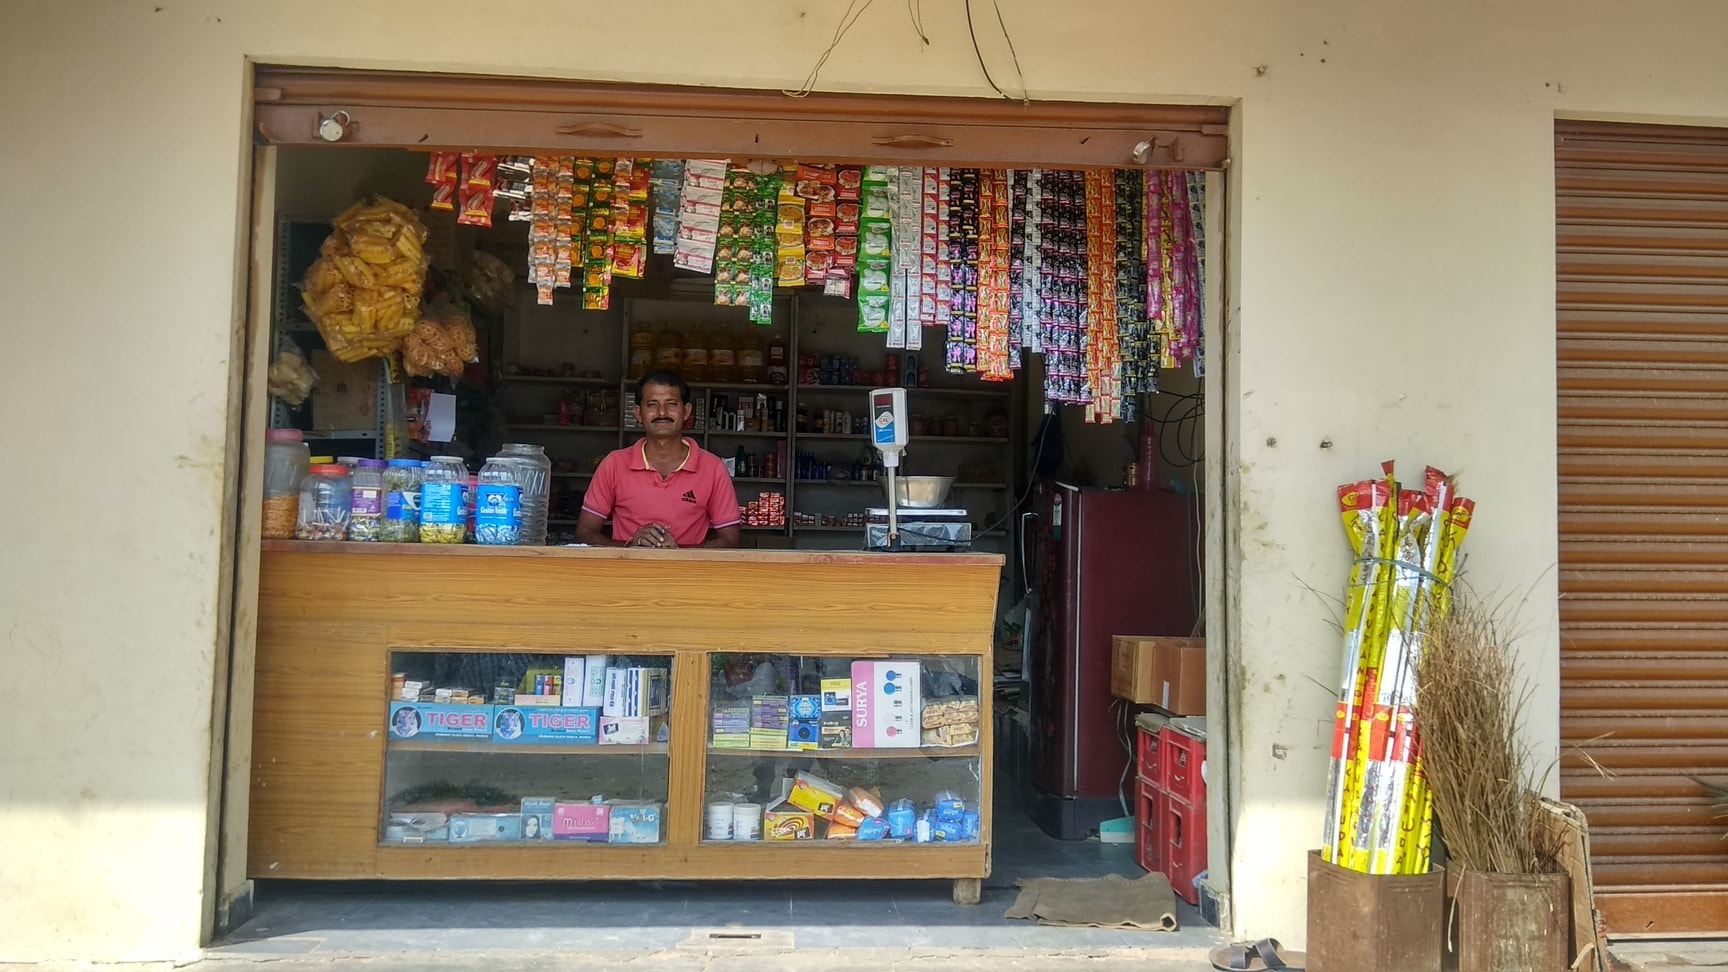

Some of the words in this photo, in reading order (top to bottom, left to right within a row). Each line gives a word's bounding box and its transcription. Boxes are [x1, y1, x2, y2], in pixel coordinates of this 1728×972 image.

[856, 681, 868, 728] SURYA
[426, 712, 488, 728] TIGER
[529, 713, 591, 729] TIGER
